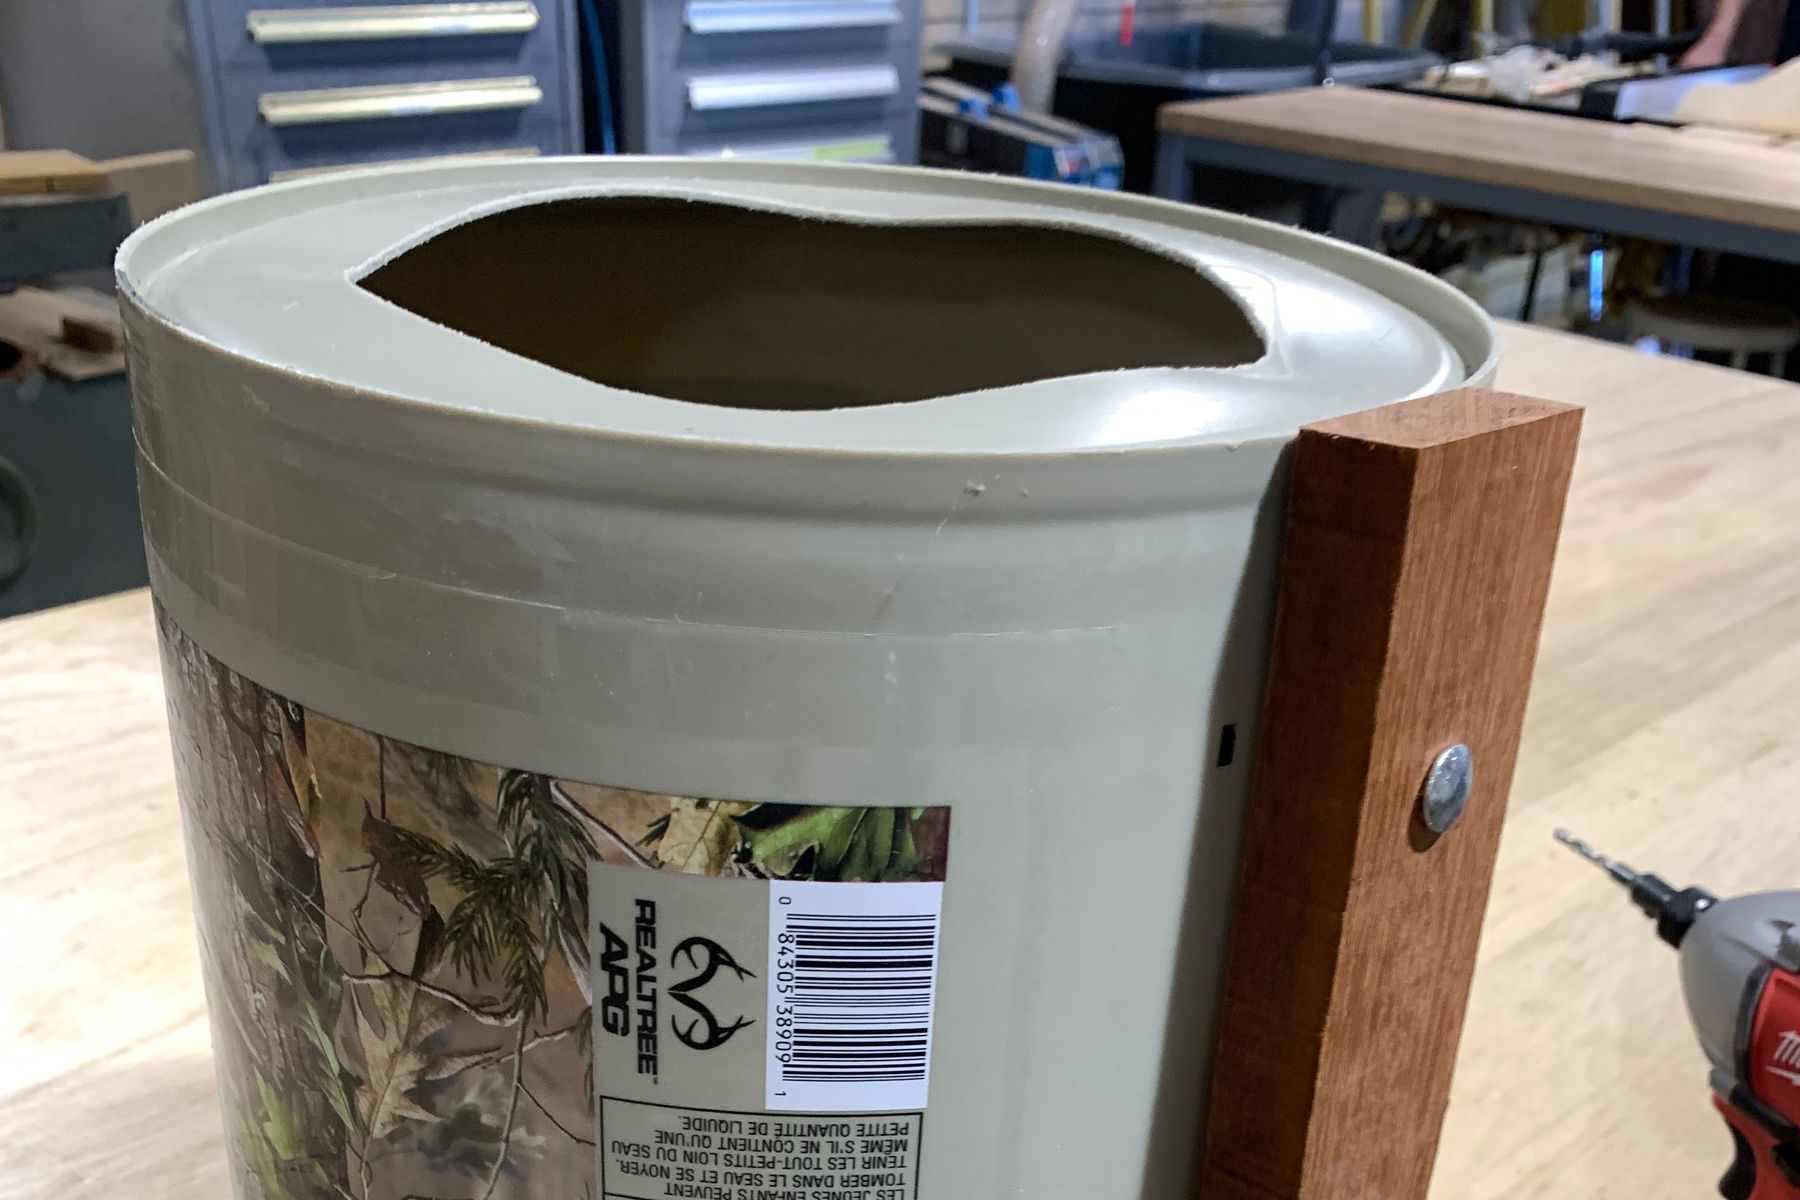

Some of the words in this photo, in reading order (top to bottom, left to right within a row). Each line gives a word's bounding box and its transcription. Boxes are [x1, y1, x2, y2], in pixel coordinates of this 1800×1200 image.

[778, 896, 791, 905] 0
[777, 933, 794, 994] 84305
[600, 922, 629, 1037] APG
[775, 1005, 793, 1063] 38909
[678, 1116, 743, 1132] LIQUIDE.
[747, 1122, 768, 1133] DE
[856, 1122, 909, 1136] PETITE
[774, 1123, 850, 1141] QUANTITÉ
[655, 1130, 712, 1149] QU'UNE
[718, 1137, 795, 1152] CONTIENT
[612, 1141, 650, 1157] SEAU
[800, 1141, 820, 1152] NE
[826, 1141, 854, 1154] S'IL
[859, 1139, 908, 1154] MÊME
[656, 1148, 677, 1161] DU
[683, 1150, 718, 1164] LOIN
[723, 1153, 822, 1169] TOUT-PETITS
[616, 1160, 670, 1178] NOYER.
[828, 1157, 856, 1169] LES
[862, 1156, 907, 1169] TENIR
[675, 1168, 694, 1181] SE
[700, 1170, 718, 1182] ET
[723, 1172, 763, 1185] SEAU
[769, 1176, 787, 1186] LE
[840, 1174, 905, 1187] TOMBER
[792, 1176, 834, 1188] DANS
[664, 1183, 731, 1200] PEUVENT
[876, 1189, 904, 1200] LES
